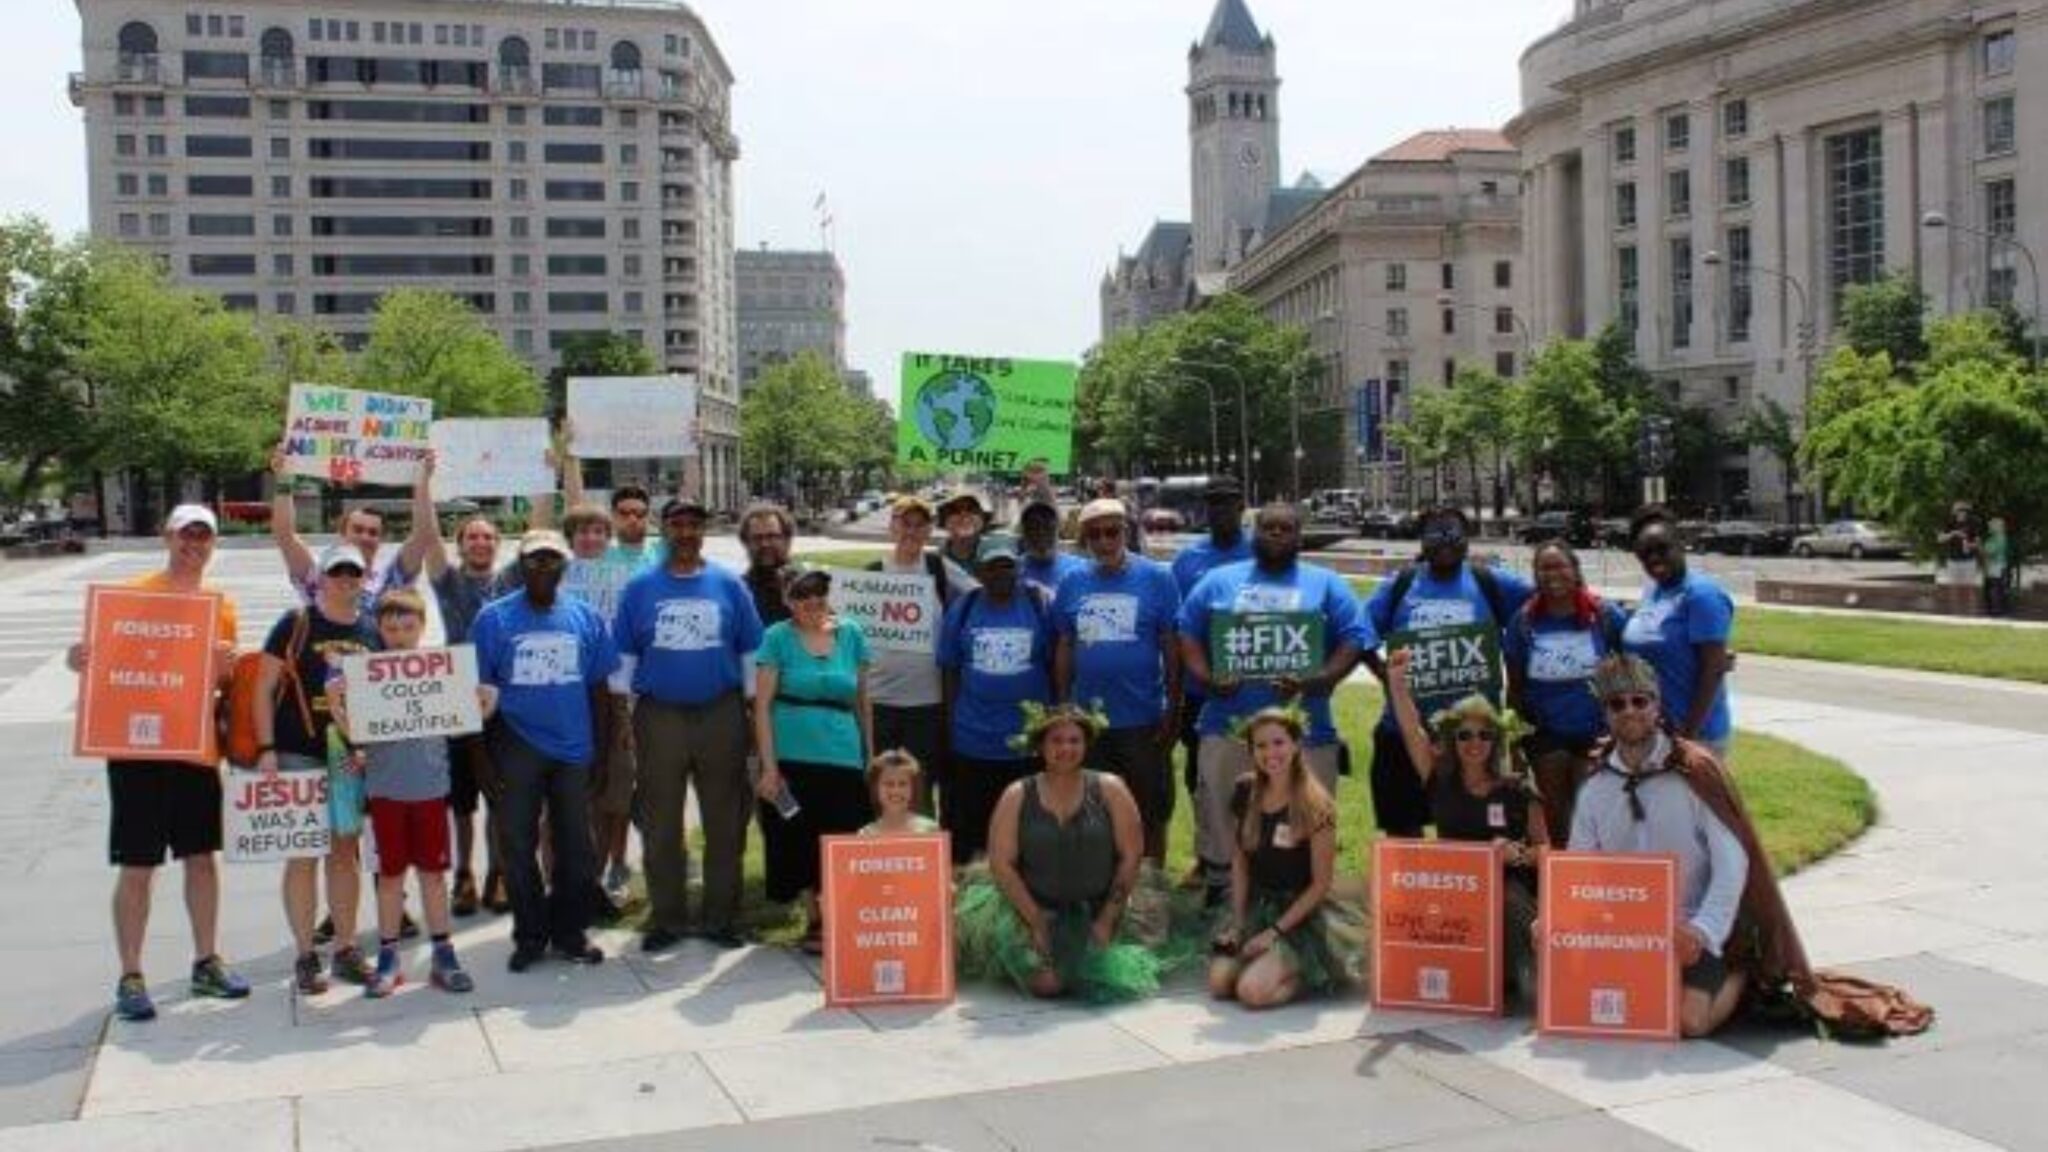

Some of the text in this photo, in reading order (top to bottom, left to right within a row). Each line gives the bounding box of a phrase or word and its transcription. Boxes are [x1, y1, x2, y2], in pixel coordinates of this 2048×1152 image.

[304, 391, 350, 413] WE
[909, 445, 1019, 468] A PLANET
[328, 456, 363, 482] US
[845, 601, 922, 624] HAS NO
[112, 620, 198, 638] FORESTS
[1223, 623, 1310, 655] #FIX
[1224, 652, 1311, 672] THE PIPES
[109, 669, 185, 688] HEALTH
[1440, 663, 1491, 685] PIPES
[380, 680, 443, 700] COLOR
[405, 699, 423, 716] IS
[367, 714, 464, 736] BEAUTIFUL
[234, 775, 328, 811] JESUS
[248, 808, 319, 831] WAS A
[849, 855, 926, 874] FORESTS
[1391, 871, 1480, 893] FORESTS
[1569, 884, 1650, 903] FORESTS
[858, 906, 919, 923] CLEAN
[856, 930, 919, 948] WATER
[1550, 931, 1669, 951] COMMUNITY
